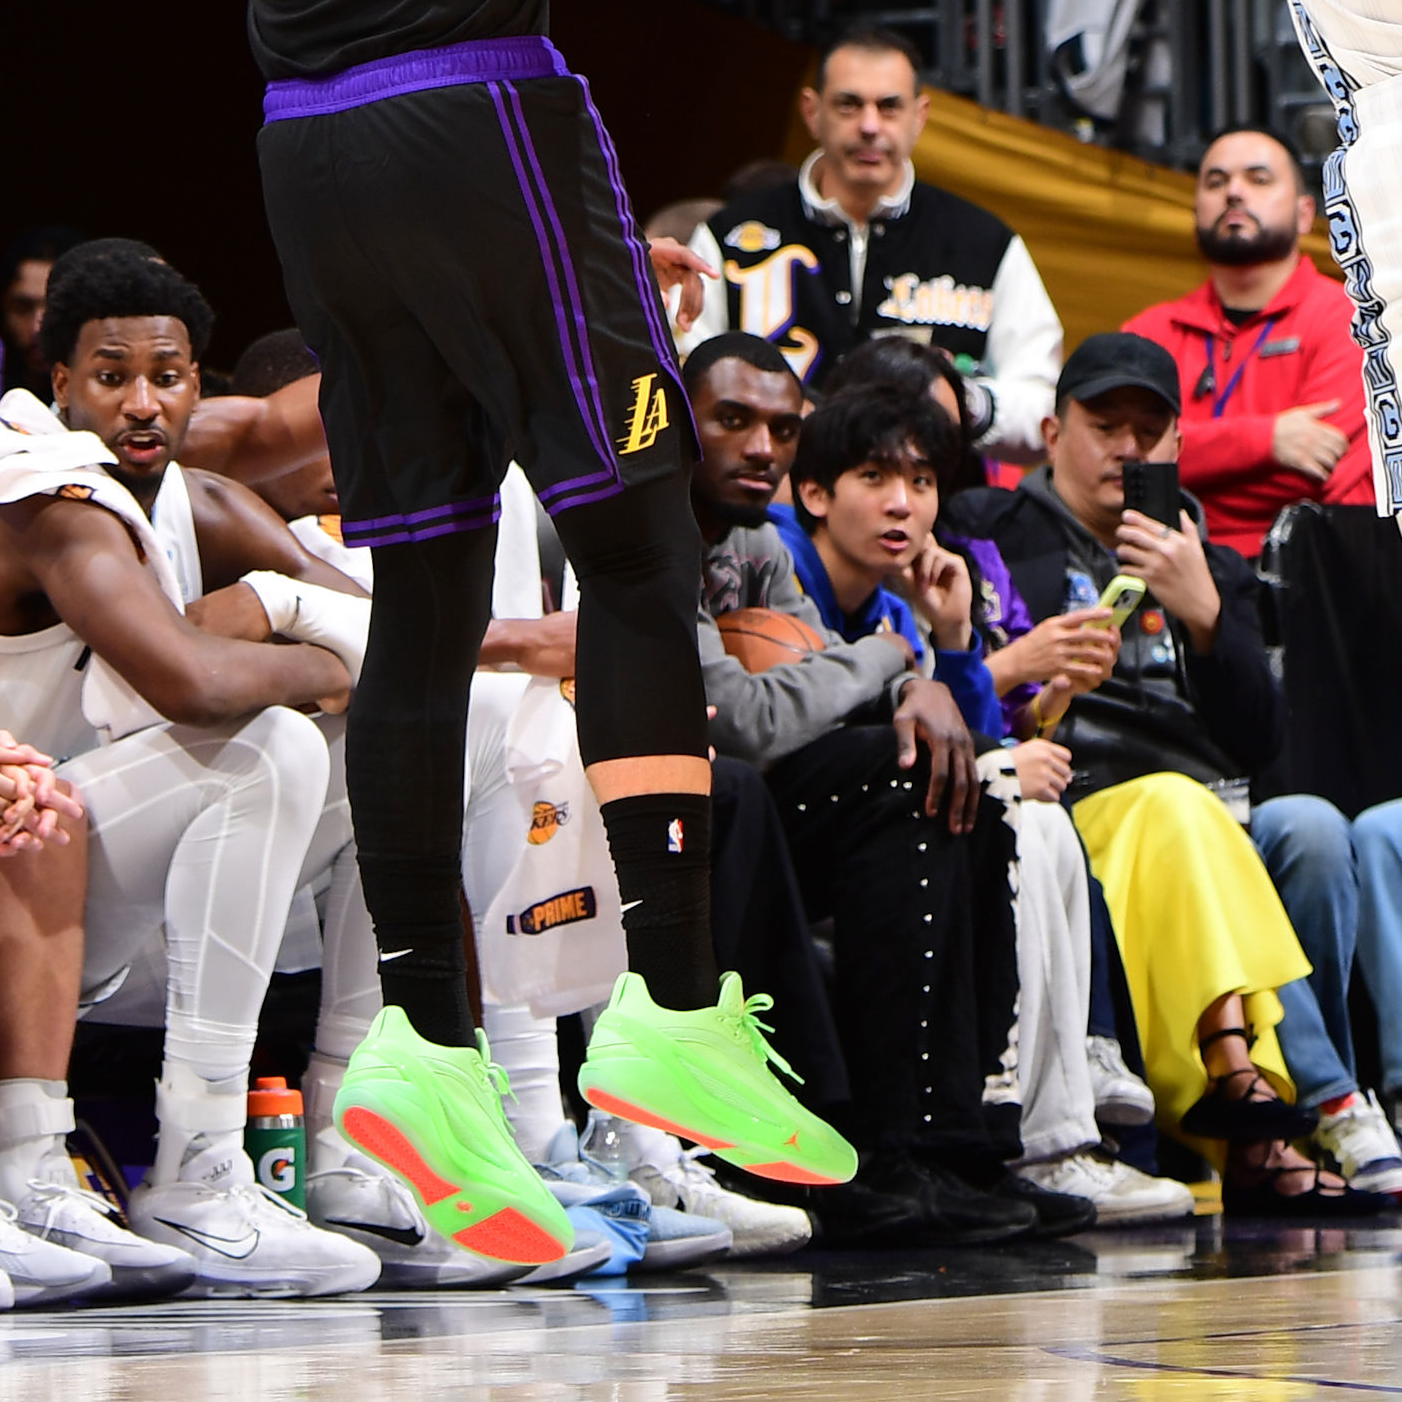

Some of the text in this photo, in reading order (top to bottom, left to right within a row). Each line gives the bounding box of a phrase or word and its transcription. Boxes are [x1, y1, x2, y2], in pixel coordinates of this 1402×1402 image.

[615, 372, 669, 456] LA
[532, 891, 587, 931] PRIME
[258, 1147, 296, 1193] G
